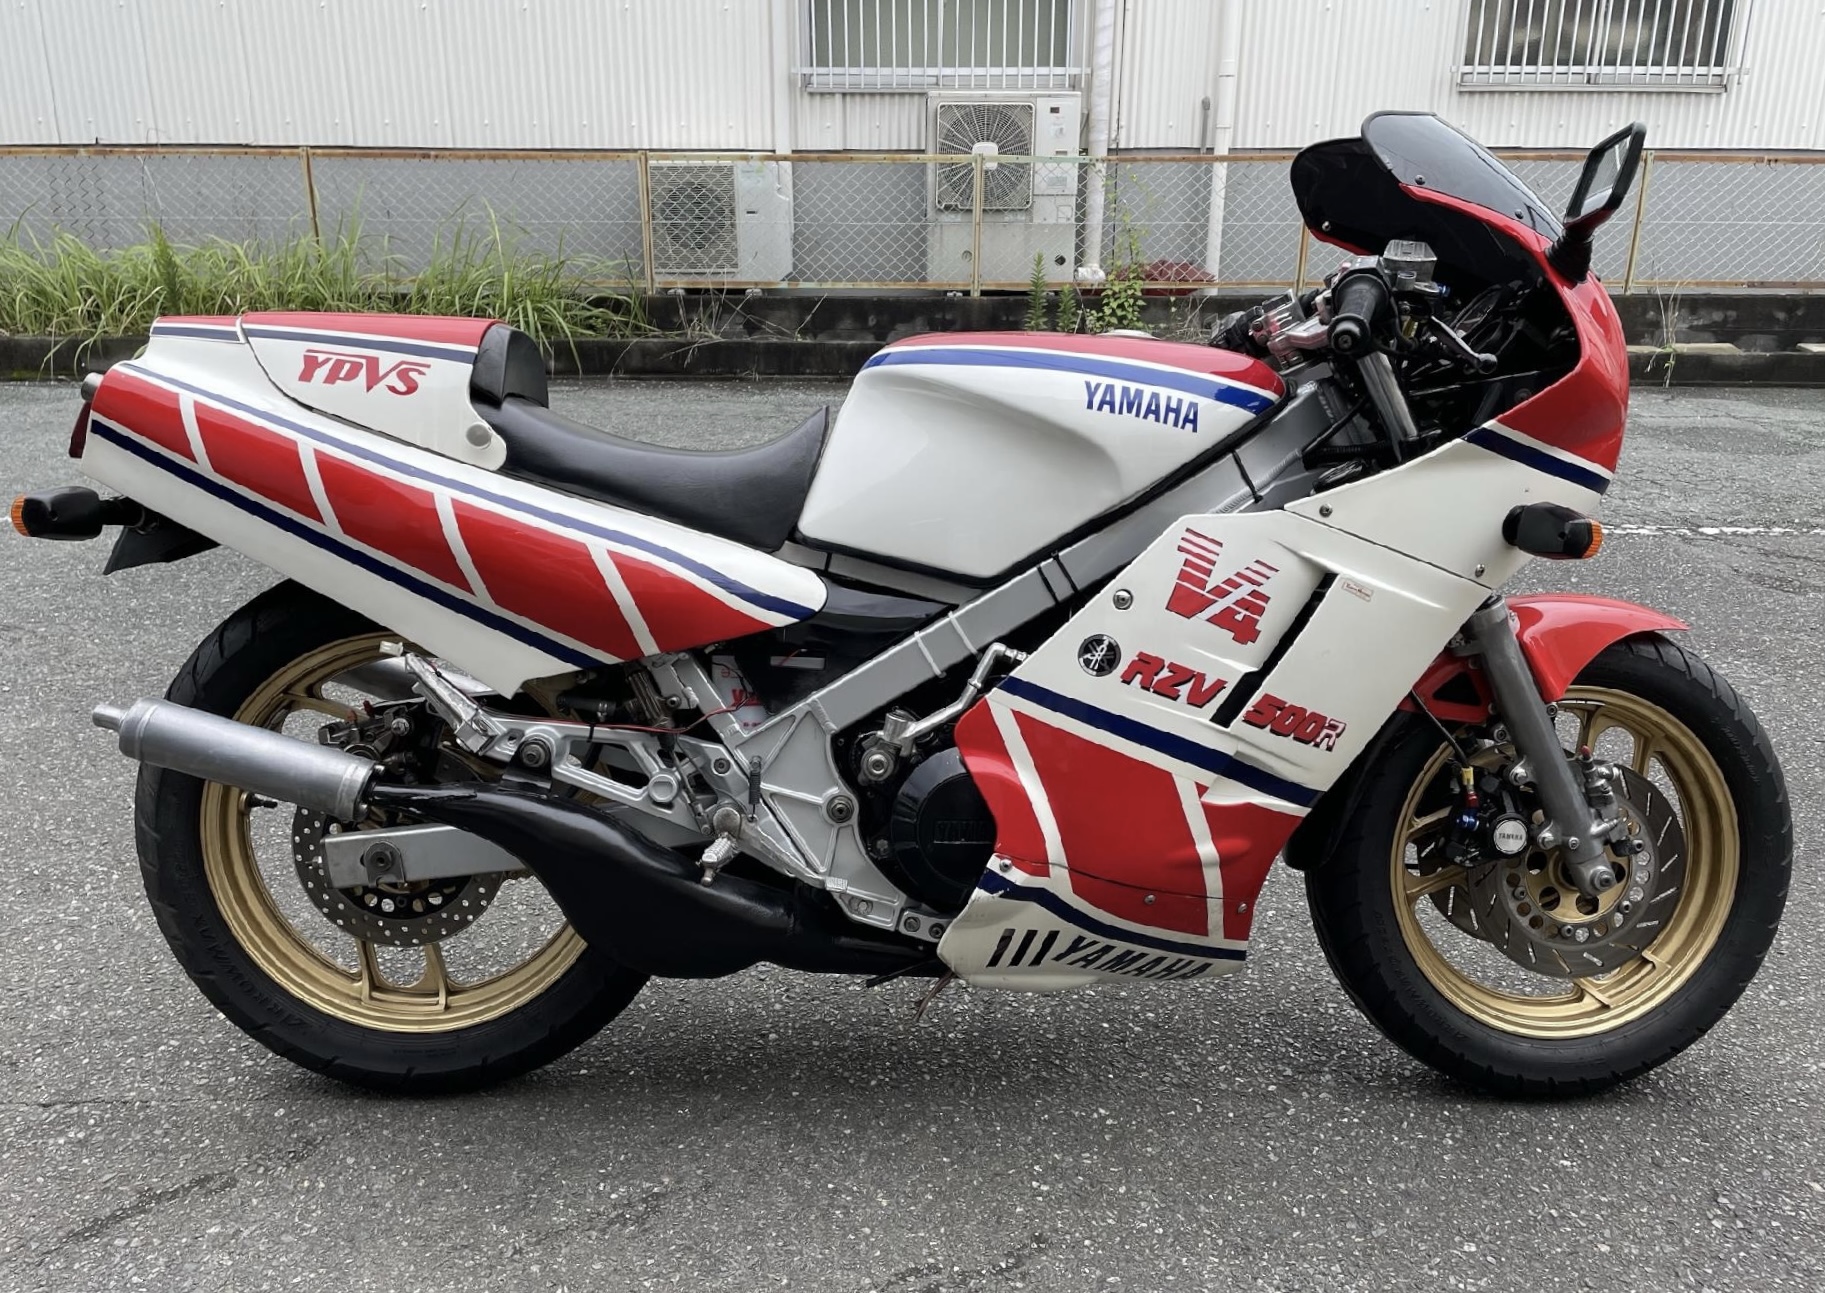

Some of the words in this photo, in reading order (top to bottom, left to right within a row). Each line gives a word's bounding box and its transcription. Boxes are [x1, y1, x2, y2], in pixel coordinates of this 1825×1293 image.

[298, 349, 431, 396] YPVS
[1084, 380, 1199, 433] YAMAHA
[1120, 651, 1228, 709] RZV
[1242, 693, 1347, 752] 500R
[1498, 832, 1523, 840] YAMAHA
[1051, 935, 1213, 980] YAMAHA
